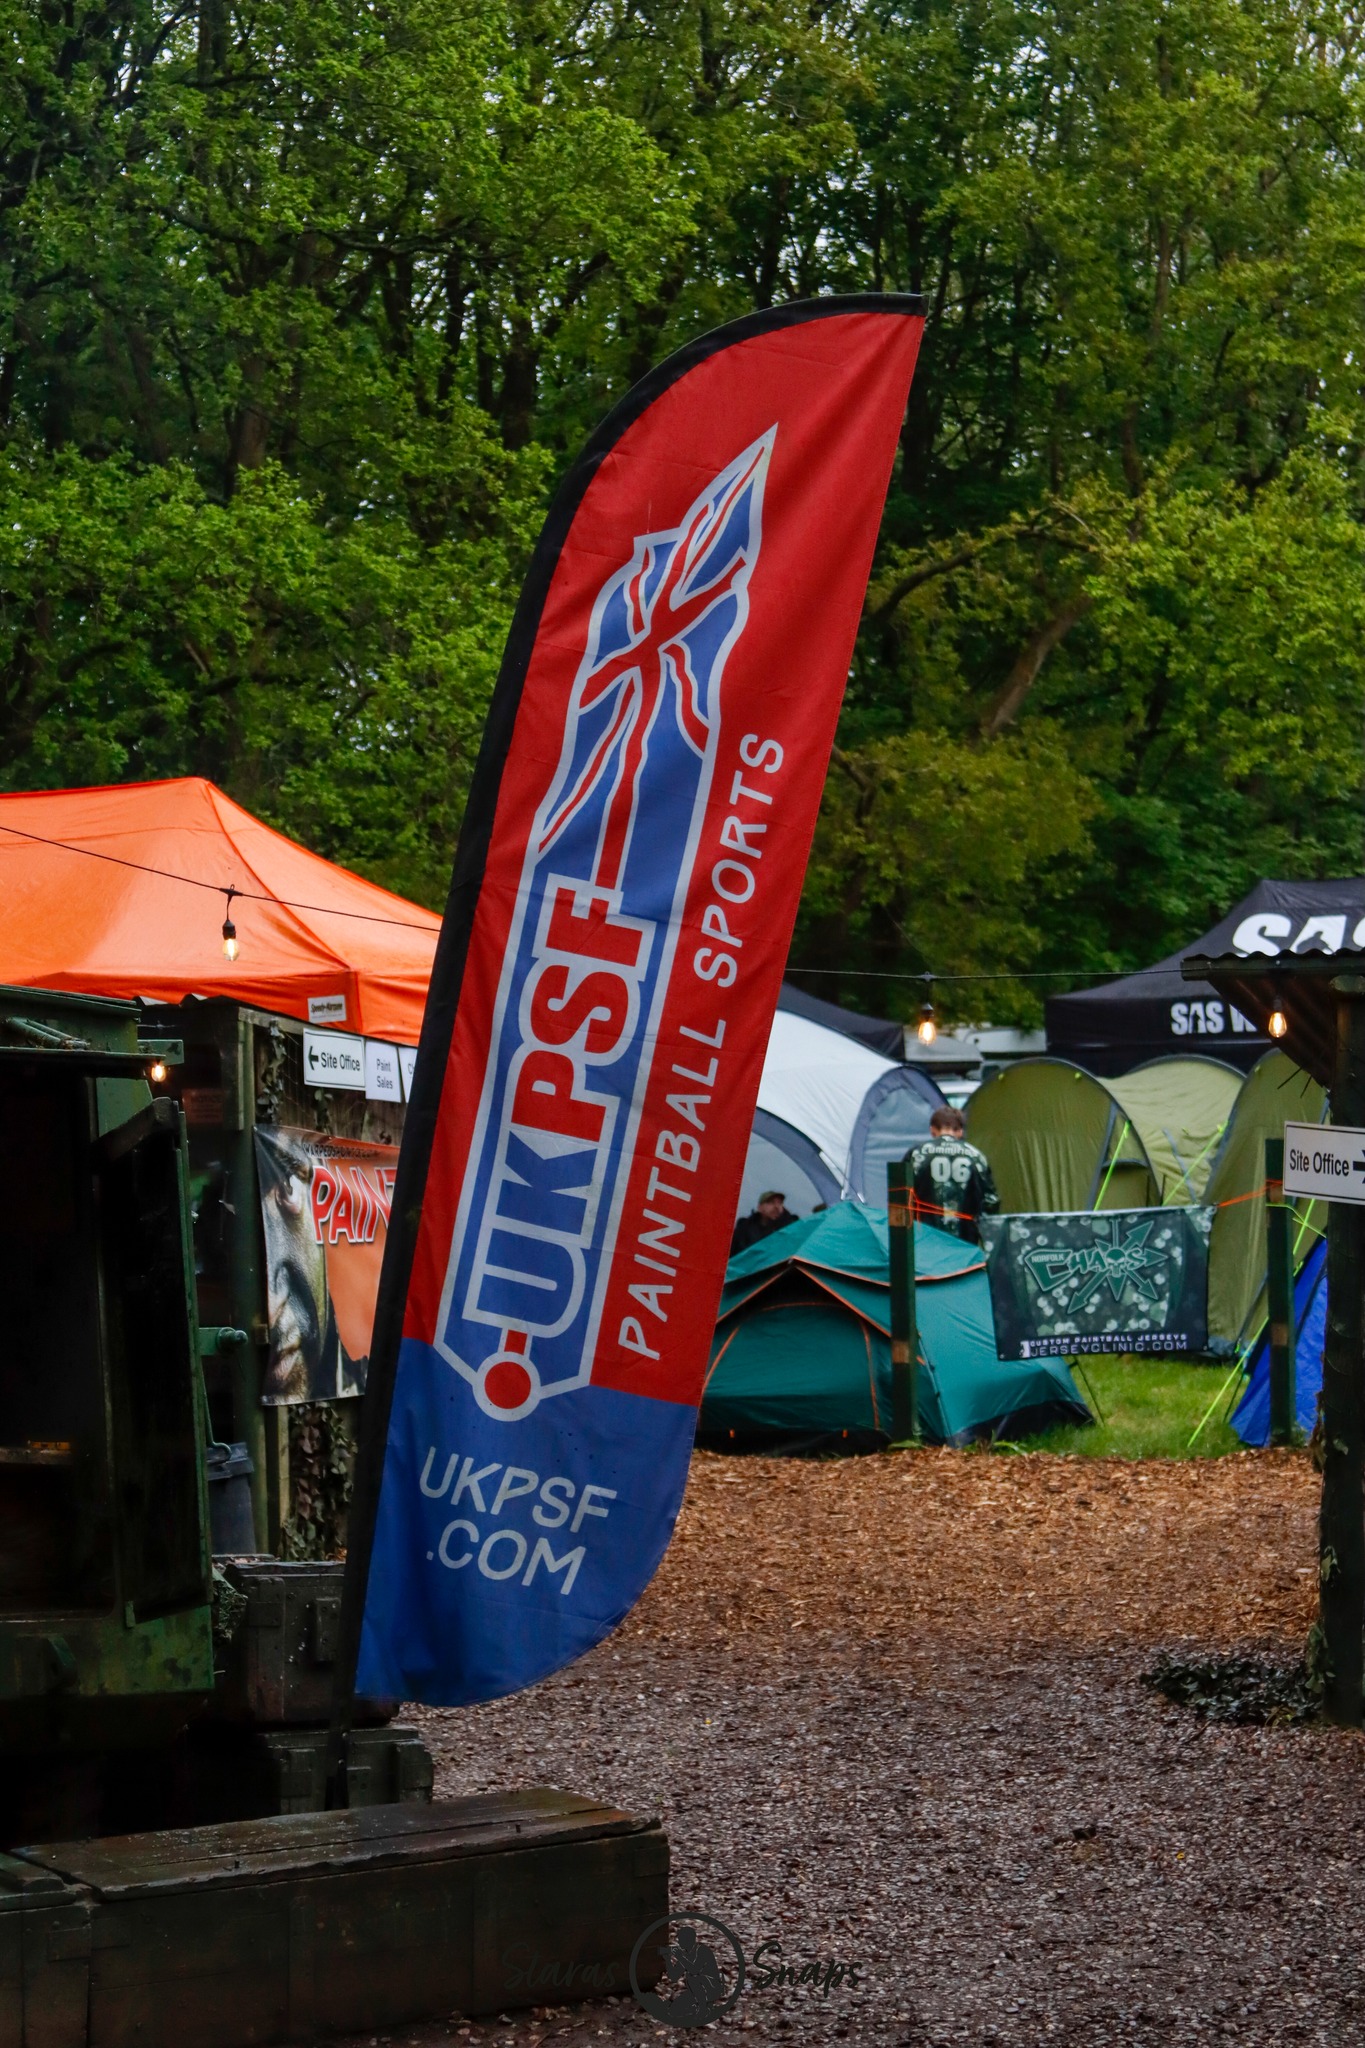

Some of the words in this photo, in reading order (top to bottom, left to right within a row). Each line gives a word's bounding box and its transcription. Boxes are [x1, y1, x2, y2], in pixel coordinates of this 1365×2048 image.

[1170, 1000, 1225, 1036] SAS
[618, 1018, 725, 1361] PAINTBALL
[693, 733, 784, 988] SPORTS
[320, 1052, 338, 1069] Site
[339, 1054, 361, 1072] Office
[376, 1058, 392, 1073] Paint
[376, 1075, 394, 1090] Sales
[461, 873, 657, 1338] UKPSF
[930, 1155, 972, 1183] 06
[1289, 1148, 1310, 1172] Site
[1313, 1151, 1350, 1177] Office
[1031, 1251, 1065, 1263] NORFOLK
[1030, 1337, 1071, 1347] CUSTOM
[1074, 1335, 1133, 1344] PAINTBALL
[1137, 1333, 1188, 1343] JERSEYS
[1030, 1341, 1188, 1357] JERSEYCLINIC.COM
[419, 1446, 618, 1533] UKPSF
[426, 1519, 586, 1596] .COM
